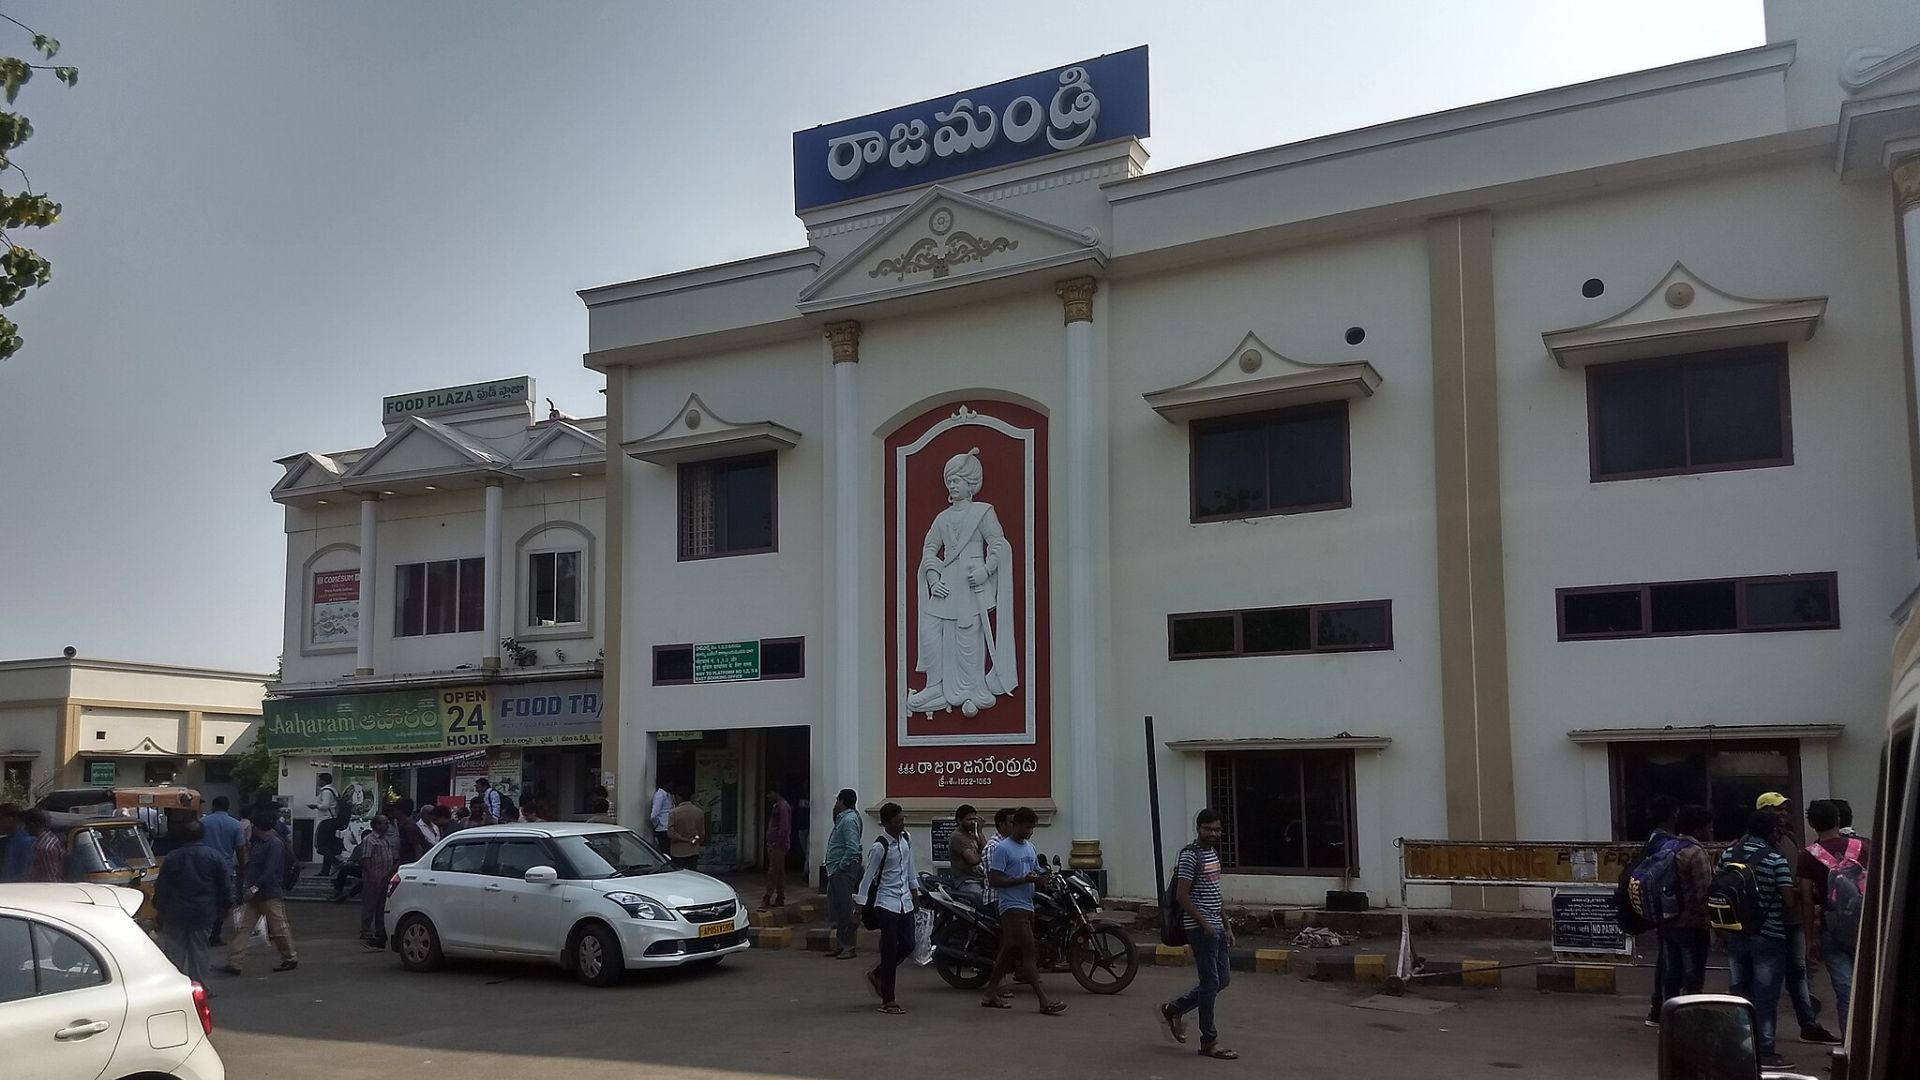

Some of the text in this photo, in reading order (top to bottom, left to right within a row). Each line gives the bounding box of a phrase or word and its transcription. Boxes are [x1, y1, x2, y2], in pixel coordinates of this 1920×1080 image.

[827, 66, 1101, 181] రాజమండ్రి
[386, 390, 474, 414] FOOD PLAZA
[443, 690, 487, 704] OPEN
[501, 696, 562, 718] FOOD
[269, 713, 355, 738] Aaharam
[359, 708, 438, 731] ఆహారం
[447, 704, 487, 733] 24
[447, 734, 490, 747] HOUR
[1592, 924, 1601, 934] NO
